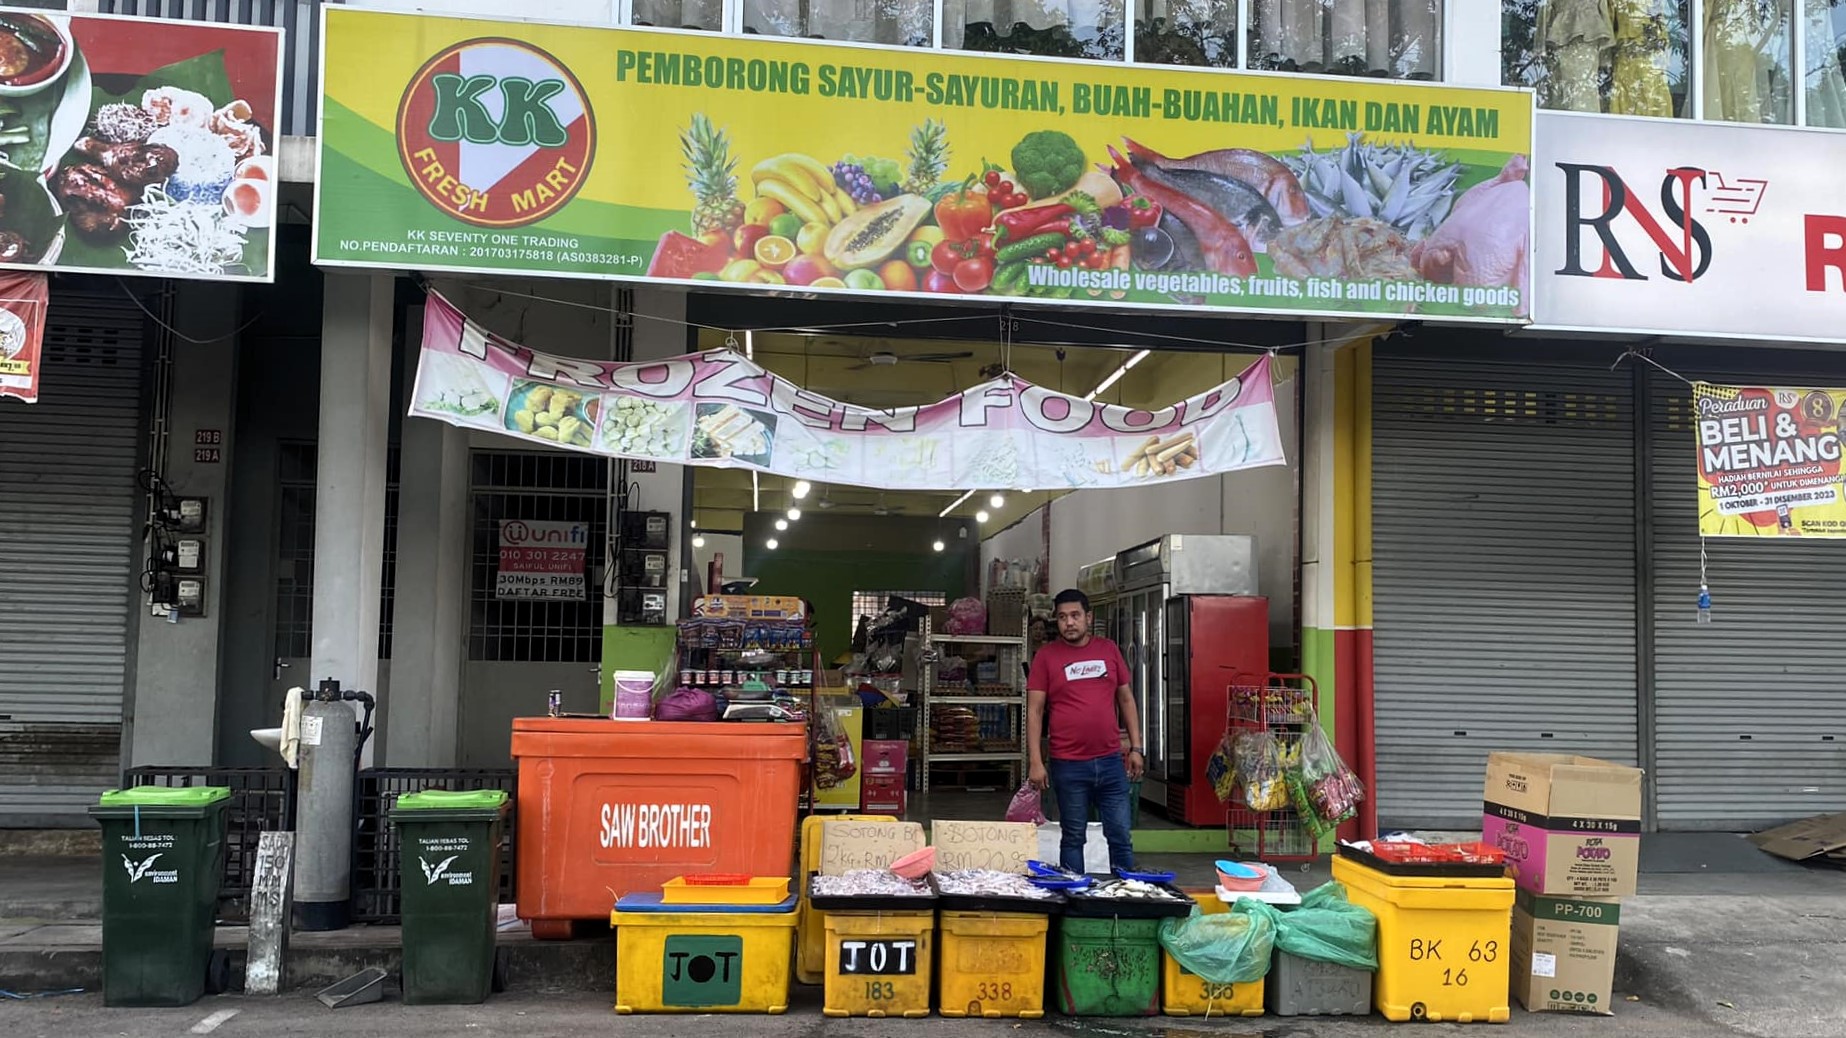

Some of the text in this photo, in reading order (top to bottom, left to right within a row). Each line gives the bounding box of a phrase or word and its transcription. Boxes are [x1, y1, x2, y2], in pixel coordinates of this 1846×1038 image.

[617, 50, 1499, 138] PEMBORONG SAYUR-SAYURAN, BUAH-BUAHAN, IKAN DAN AYAM
[429, 73, 569, 148] KK
[414, 147, 576, 213] FRESH MART
[1555, 162, 1713, 284] RNS
[407, 230, 579, 249] KK SEVENTY ONE TRADING
[340, 240, 458, 256] NO.PENDAFTARAN
[470, 246, 554, 261] 201703175818
[557, 253, 643, 268] (AS0383281-P)
[1028, 264, 1131, 289] Wholesale
[1248, 274, 1303, 299] fruits,
[1307, 278, 1341, 299] fish
[1346, 279, 1381, 300] and
[1385, 280, 1459, 304] chicken
[1463, 286, 1519, 307] goods
[459, 317, 1243, 433] FROZEN FOOD
[1699, 394, 1768, 415] Peraduan
[197, 431, 220, 443] 219 B
[1700, 412, 1798, 446] BELI &
[196, 449, 219, 461] 219 A
[1703, 435, 1840, 473] MENANG
[1718, 466, 1823, 484] HADIAH BERNILAI SEHINGGA
[1770, 479, 1798, 490] UNTUK
[1725, 500, 1759, 510] OKTOBER
[1764, 497, 1774, 506] 31
[1774, 492, 1813, 504] DISEMBER
[1814, 490, 1836, 500] 2023
[532, 526, 585, 543] unifi
[499, 550, 586, 561] 010 301 2247
[499, 575, 546, 586] 30Mbps
[497, 587, 584, 597] DAFTAR FREE
[600, 803, 712, 848] SAW BROTHER
[830, 824, 895, 840] SOTONG
[947, 824, 1021, 844] SOTONG
[1554, 903, 1602, 918] PP-700
[842, 941, 916, 973] JOT
[1409, 939, 1498, 962] BK 63
[669, 951, 739, 984] JOT
[1442, 968, 1469, 986] 16
[865, 981, 895, 1000] 183
[976, 982, 1013, 1001] 338
